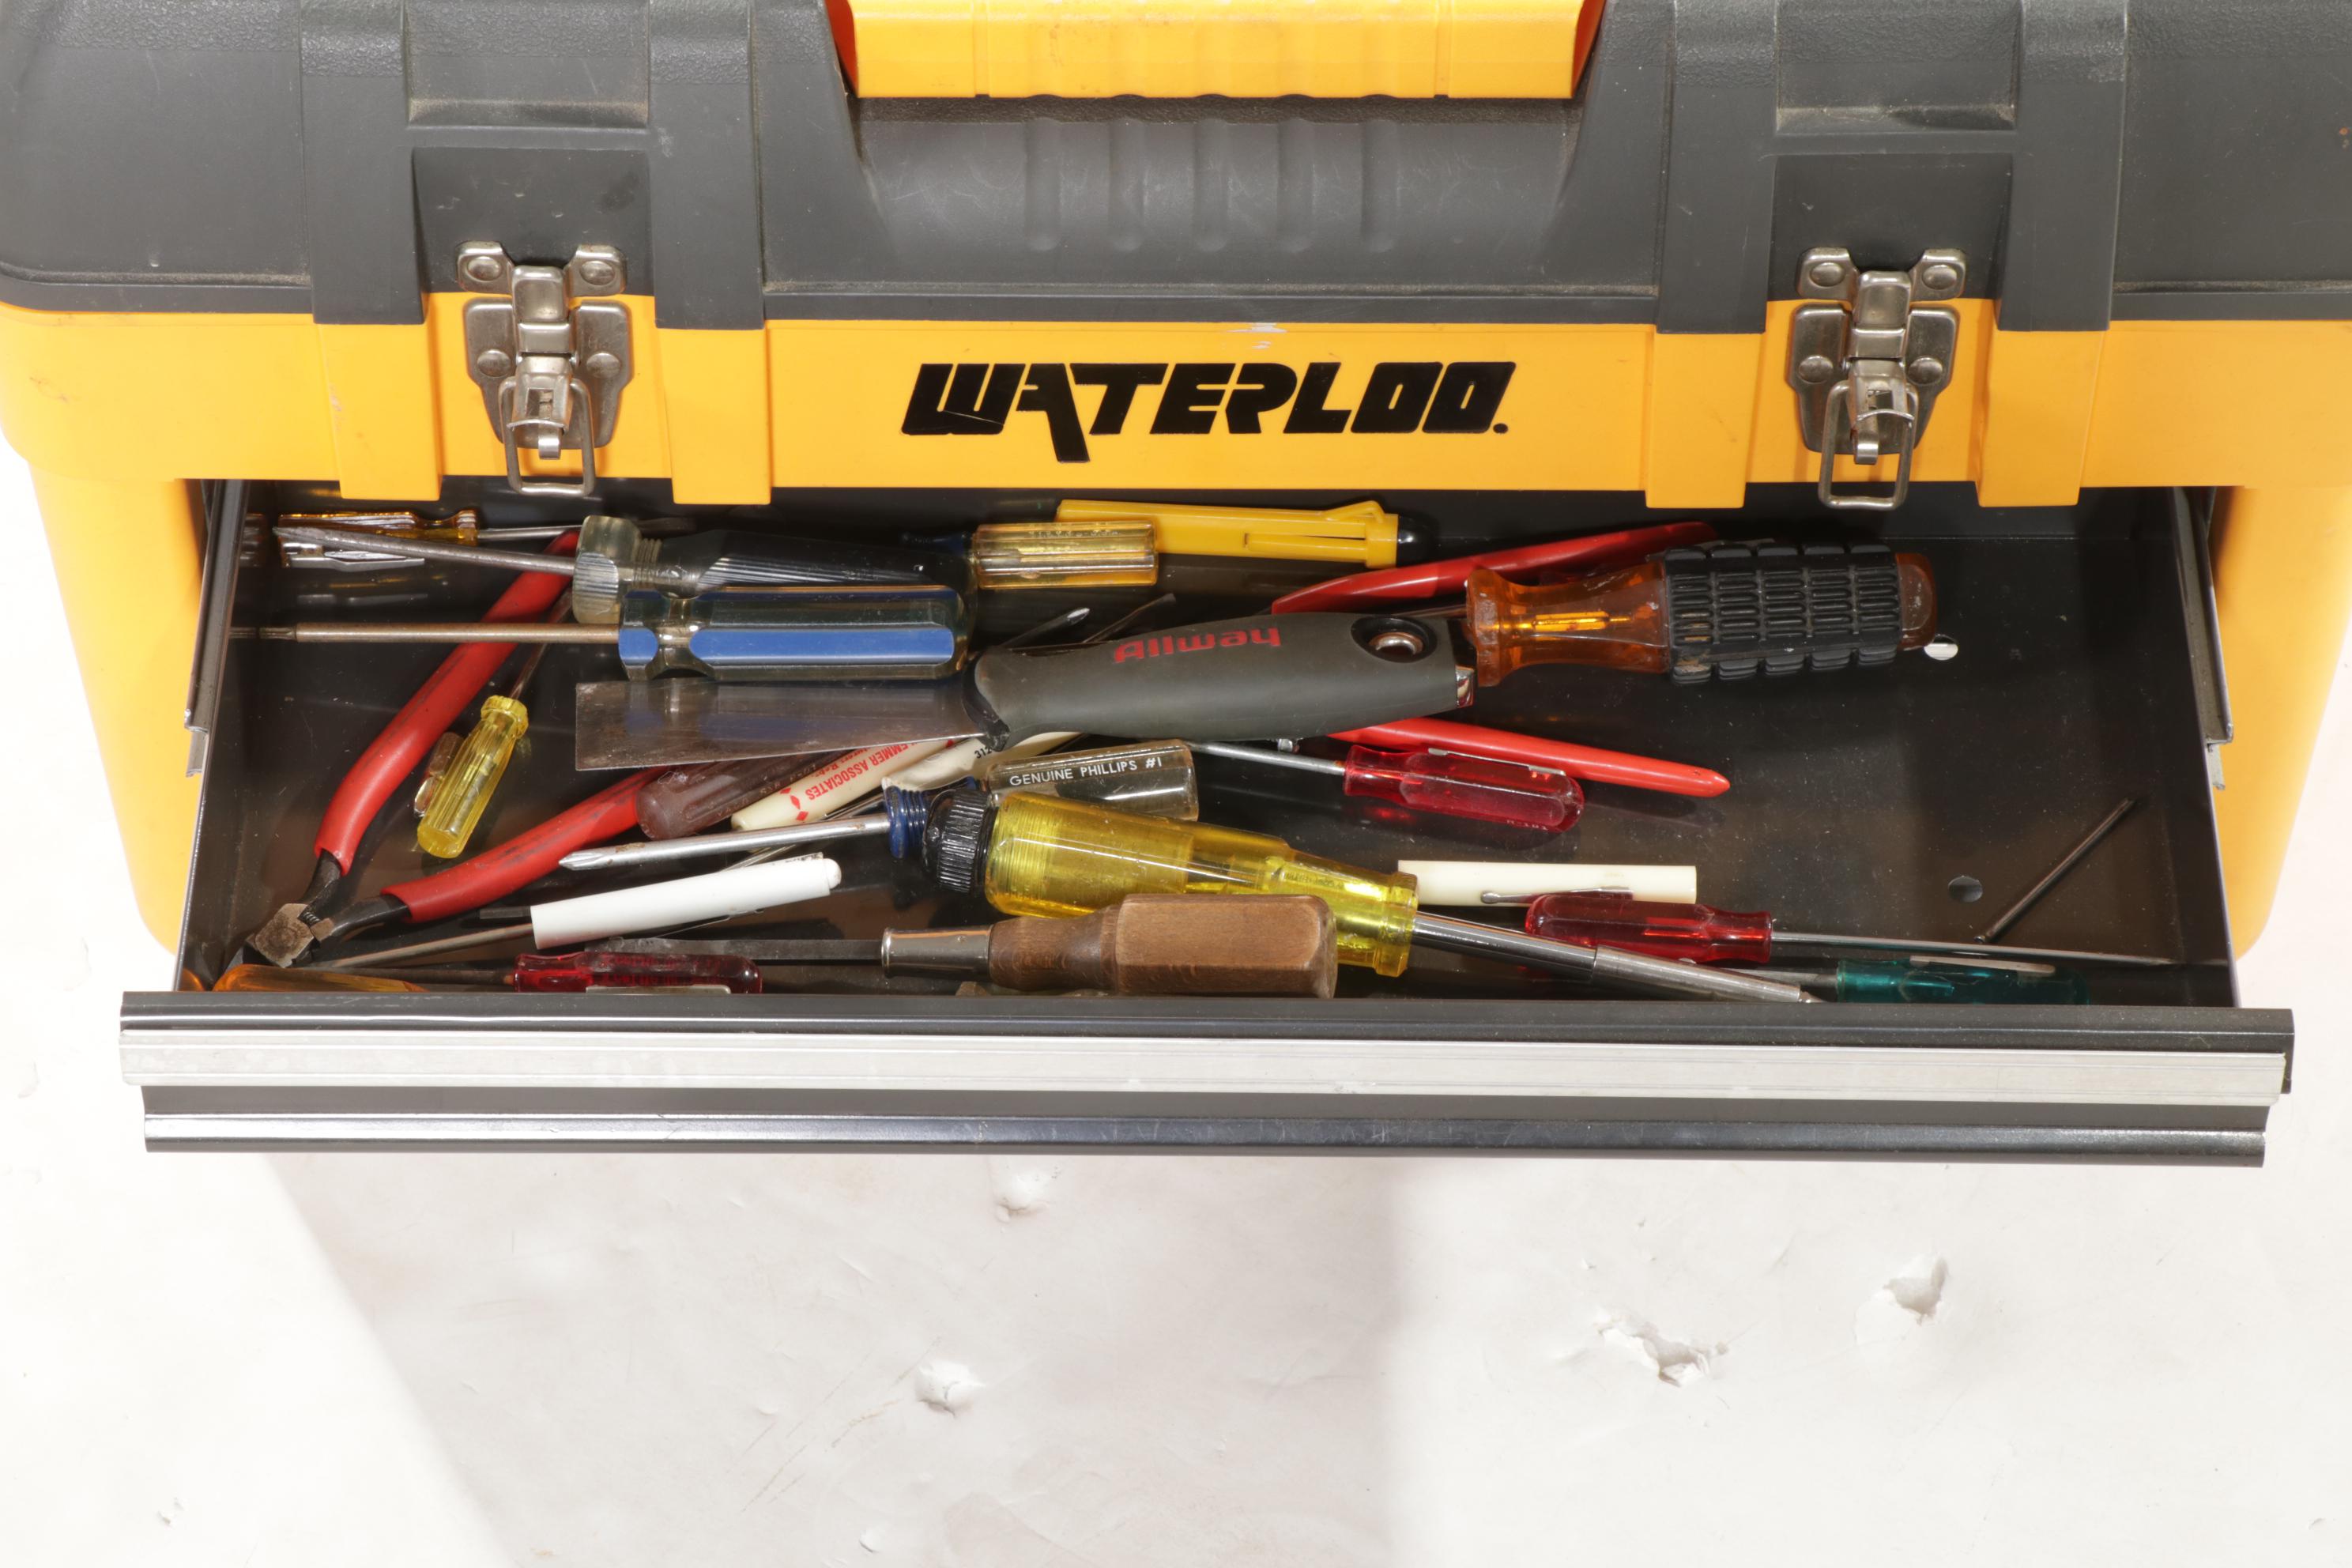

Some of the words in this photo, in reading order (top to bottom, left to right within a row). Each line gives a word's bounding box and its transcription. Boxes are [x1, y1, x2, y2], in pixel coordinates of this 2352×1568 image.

[1114, 628, 1281, 664] Allway
[805, 760, 869, 800] ASSOCIATES
[1009, 768, 1074, 786] GENUINE
[1080, 760, 1138, 778] PHILLIPS
[1145, 756, 1163, 769] #1
